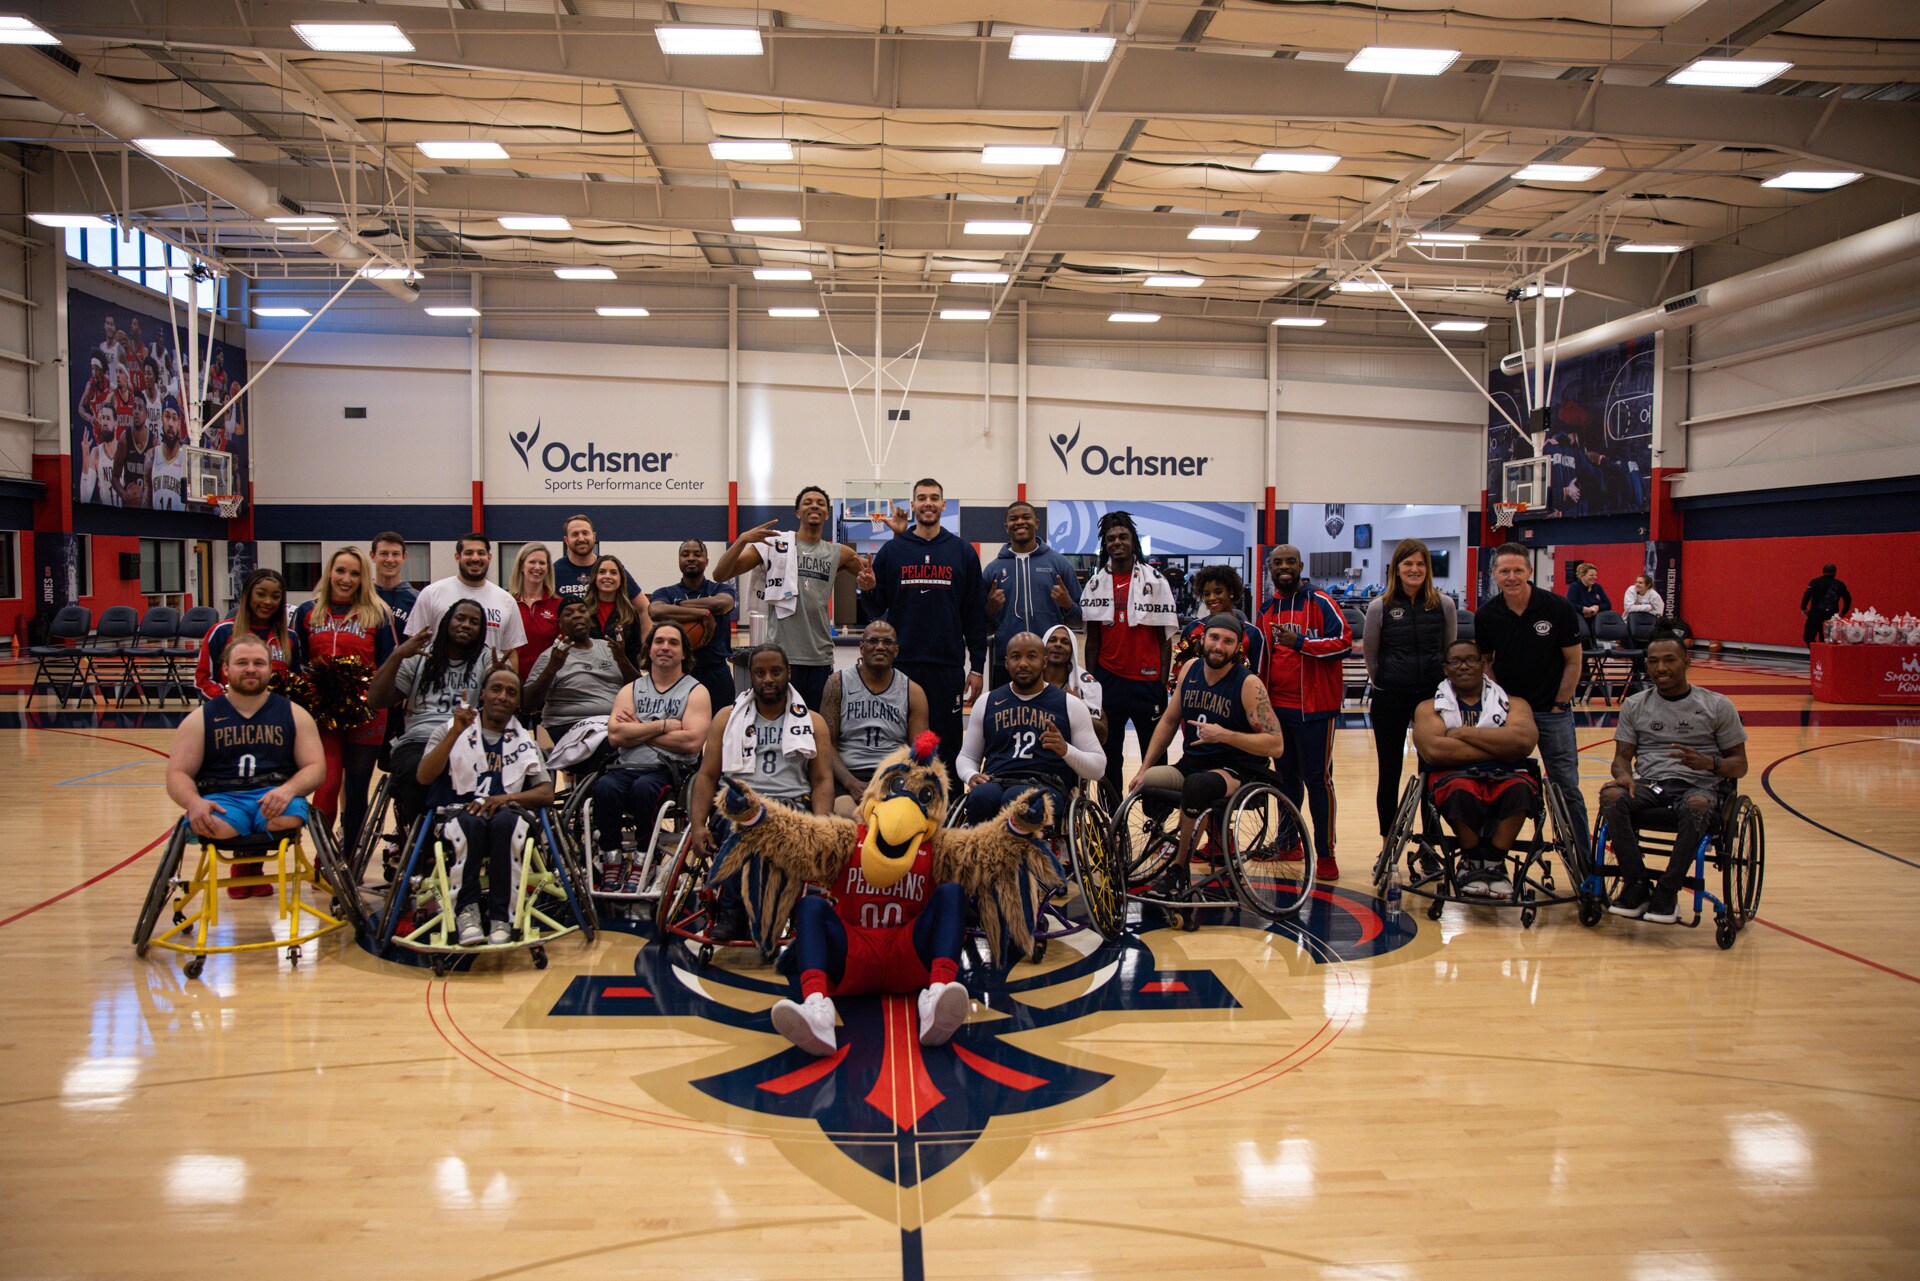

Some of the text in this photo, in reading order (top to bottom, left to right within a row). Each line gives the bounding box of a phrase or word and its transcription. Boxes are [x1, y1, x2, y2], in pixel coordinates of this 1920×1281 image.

[542, 442, 673, 473] Ochsner
[1081, 445, 1209, 476] Ochsner
[544, 477, 705, 493] Sports Performance Center
[901, 564, 953, 580] PELICANS
[43, 578, 54, 605] JONES
[847, 700, 901, 725] PELICANS
[1183, 690, 1232, 718] PELICANS
[214, 724, 284, 750] PELICANS
[1012, 731, 1036, 760] 12
[762, 750, 776, 774] 8
[474, 776, 493, 797] 4
[846, 867, 926, 902] PEANS
[860, 902, 903, 928] 00
